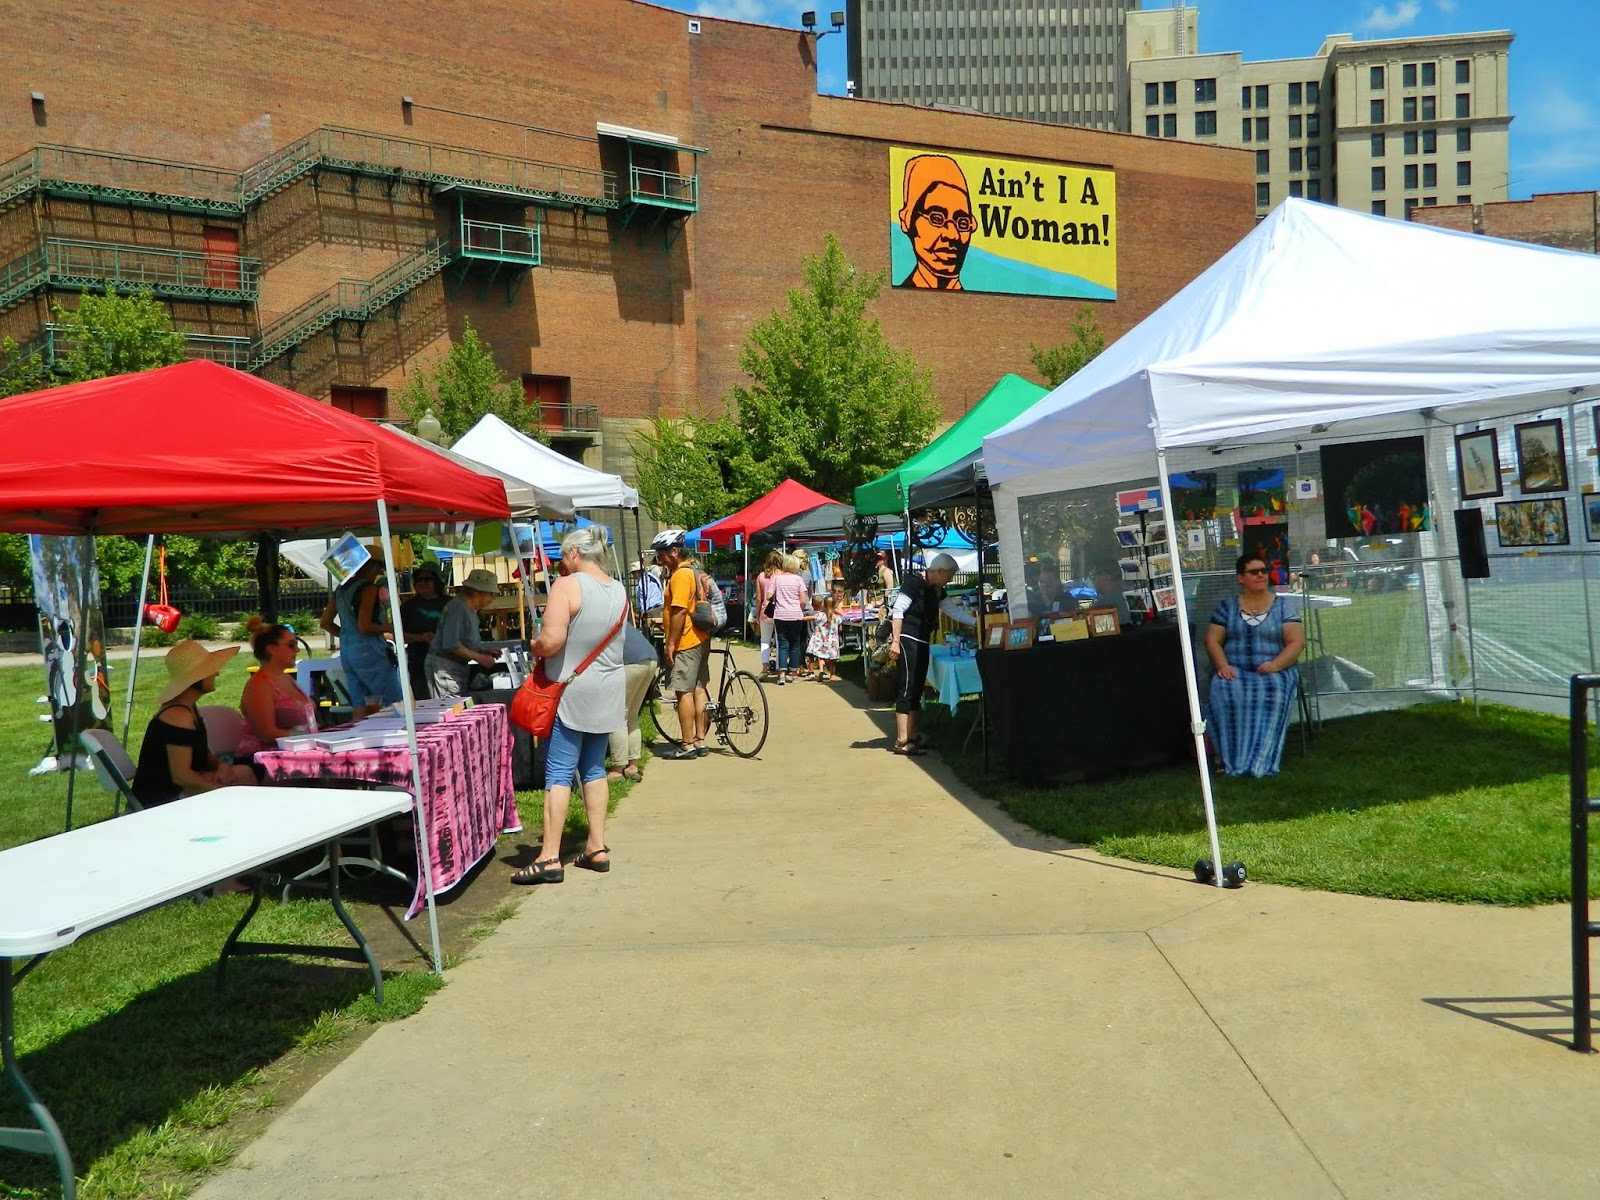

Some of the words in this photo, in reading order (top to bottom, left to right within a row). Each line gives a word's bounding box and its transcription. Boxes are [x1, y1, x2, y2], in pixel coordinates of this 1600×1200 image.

[979, 168, 1044, 202] Ain't
[1058, 175, 1067, 204] I
[1080, 177, 1099, 205] A
[978, 203, 1109, 246] Woman!
